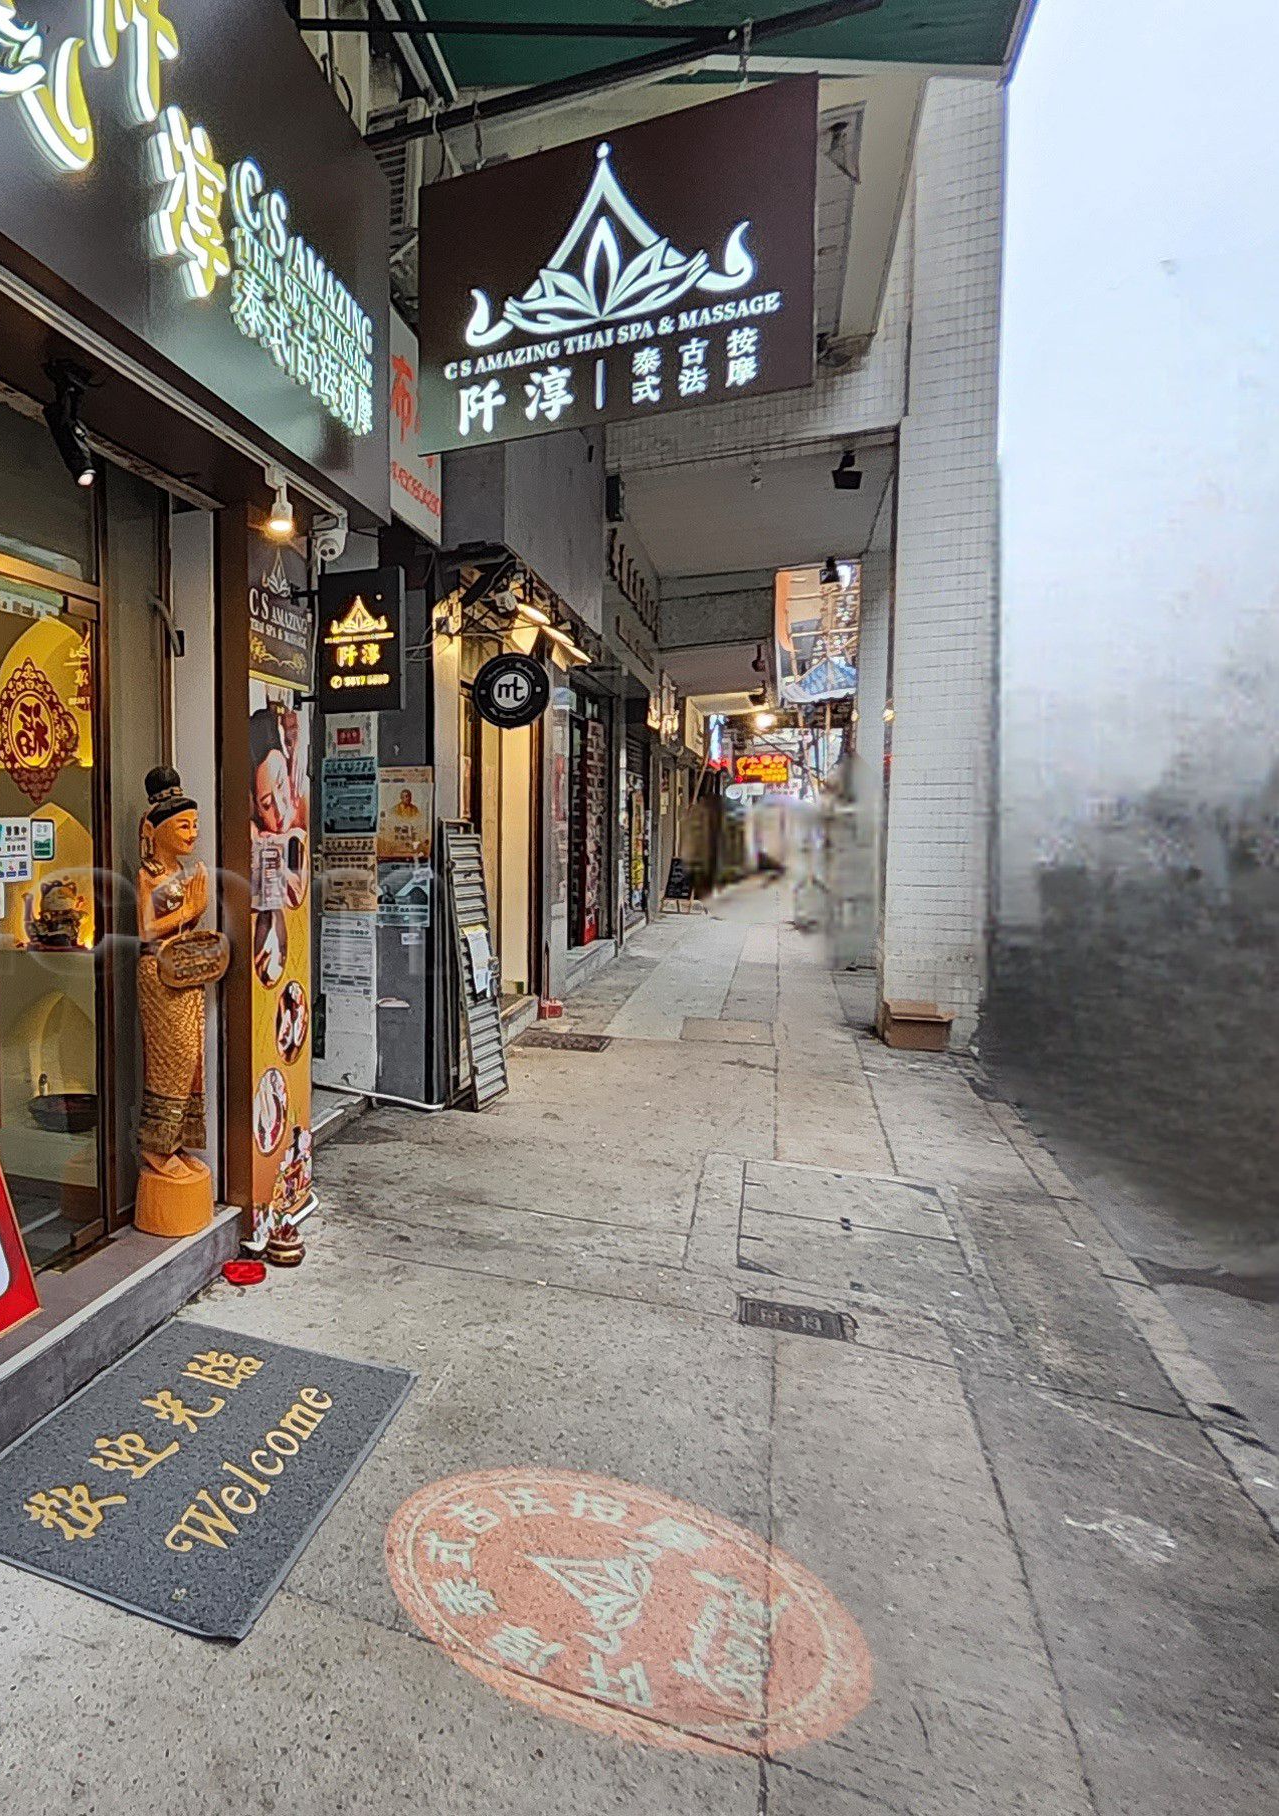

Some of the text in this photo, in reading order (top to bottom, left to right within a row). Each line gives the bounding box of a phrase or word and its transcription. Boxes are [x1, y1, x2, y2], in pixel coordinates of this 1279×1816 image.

[231, 226, 282, 297] THAI
[284, 237, 372, 355] AMAZING
[229, 267, 372, 435] 泰式古法按摩
[458, 326, 759, 437] 阡淳 泰式 古法 按摩
[474, 340, 561, 376] AMAZING
[563, 327, 615, 356] THAI
[616, 322, 654, 346] SPA
[657, 315, 676, 336] &
[678, 291, 781, 330] MASSAGE
[23, 1349, 264, 1541] 歡迎光臨
[164, 1385, 334, 1553] Welcome
